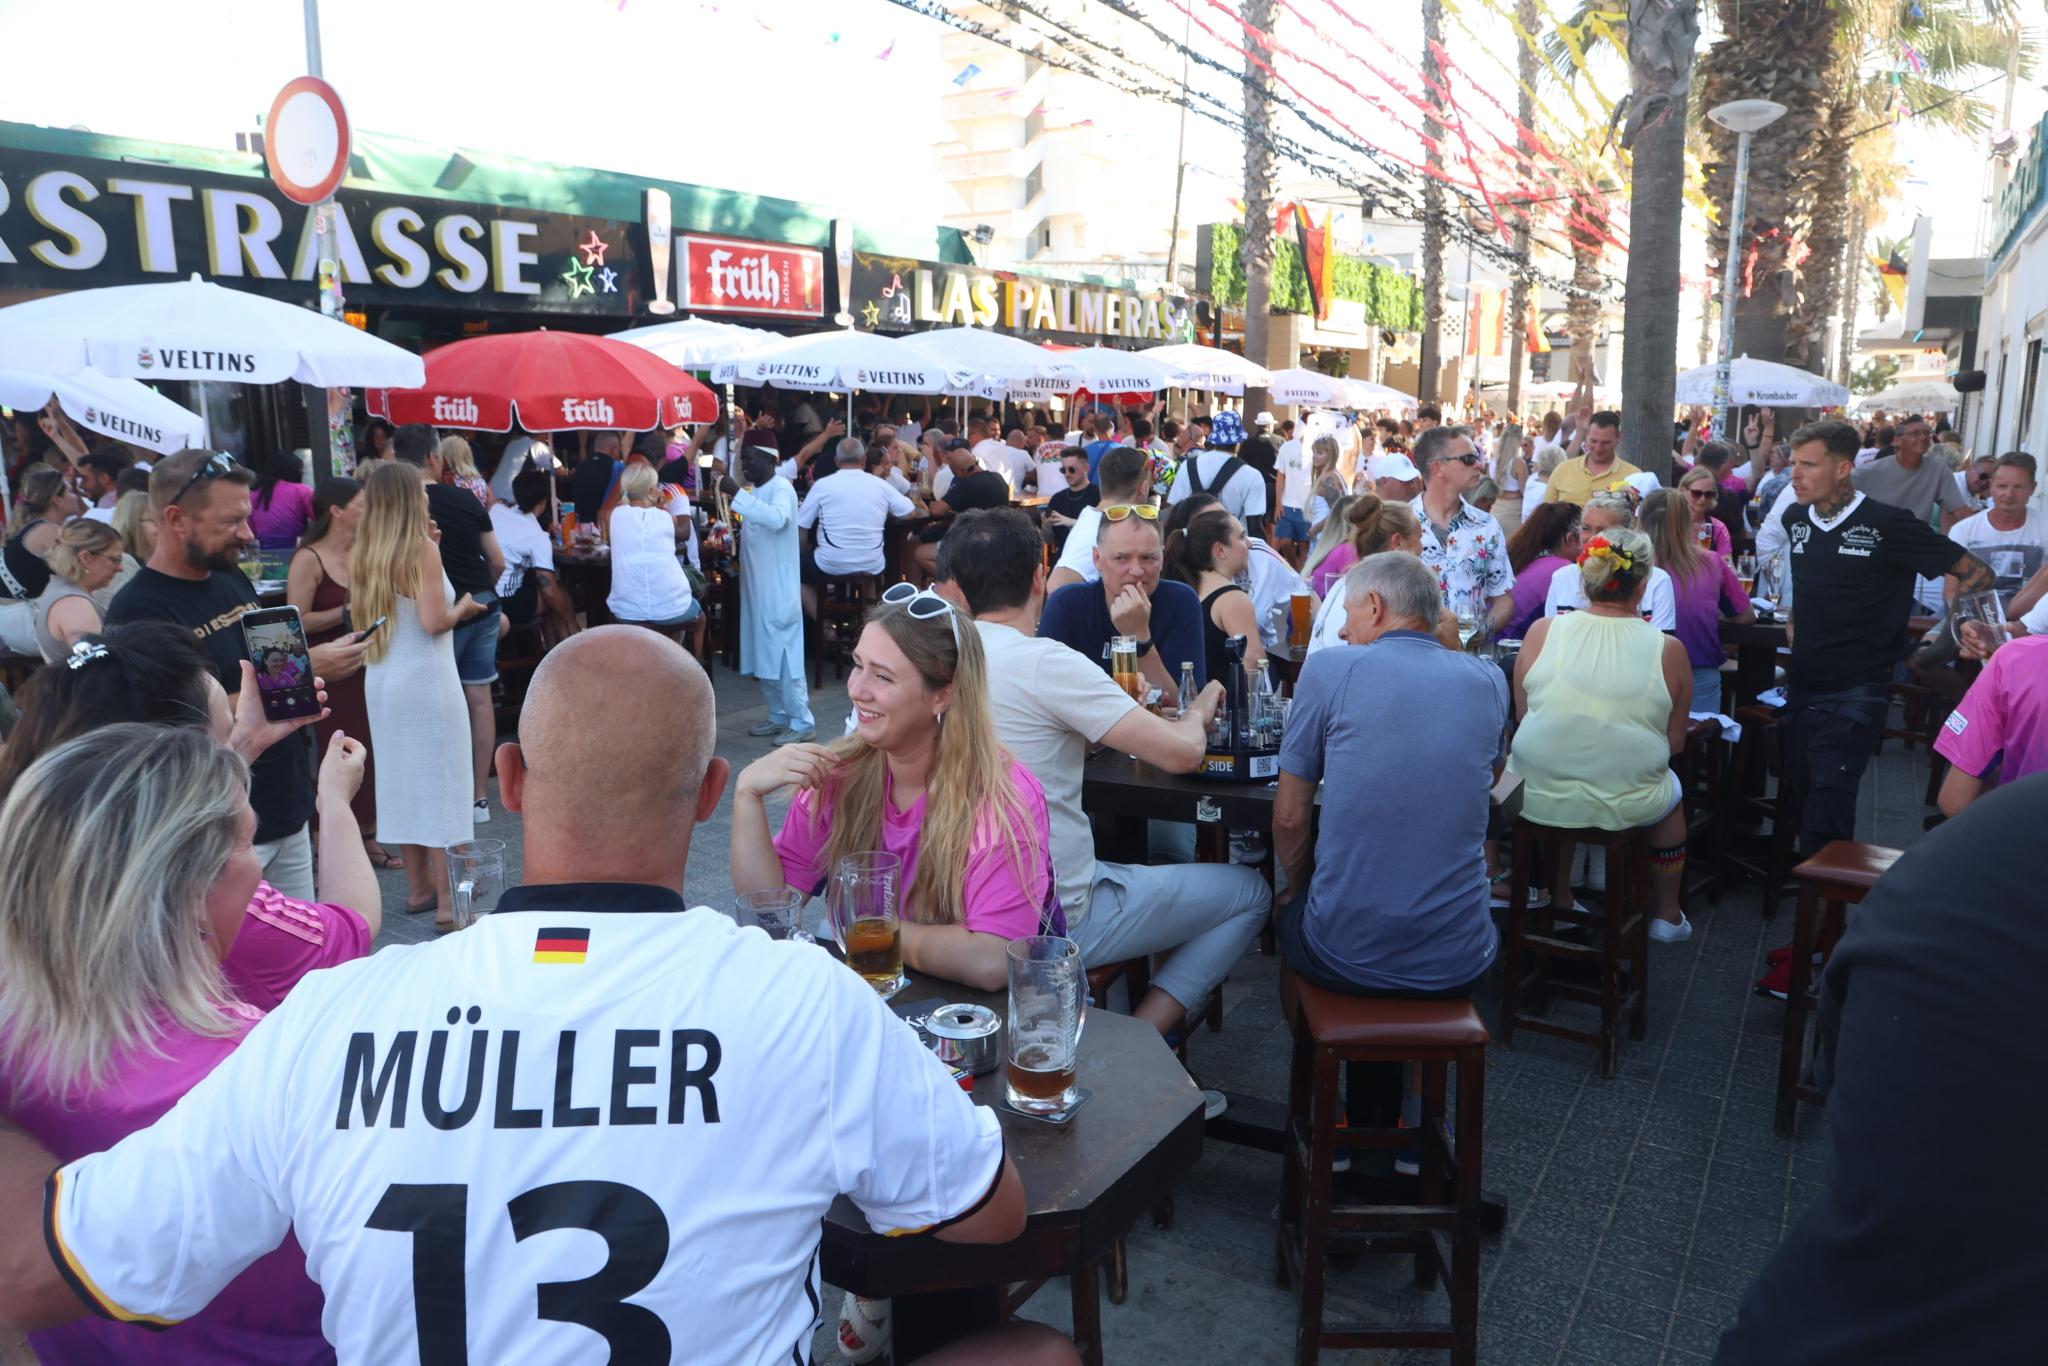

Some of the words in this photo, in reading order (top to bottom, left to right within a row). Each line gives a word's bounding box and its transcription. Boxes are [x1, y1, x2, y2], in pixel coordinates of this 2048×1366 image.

[0, 170, 541, 295] STRASSE
[915, 269, 1000, 327] LAS
[1004, 280, 1177, 341] PALMERAS
[160, 348, 256, 373] VELTINS
[768, 363, 821, 379] VELTINS
[869, 370, 925, 386] VELTINS
[1033, 377, 1071, 390] VELTINS
[1107, 377, 1151, 389] VELTINS
[1290, 389, 1319, 398] VELTINS
[1756, 391, 1799, 401] Krombacher
[100, 410, 162, 444] VELTINS
[1208, 760, 1233, 772] SIDE
[335, 1005, 722, 1131] MÜLLER
[364, 1180, 673, 1366] 13
